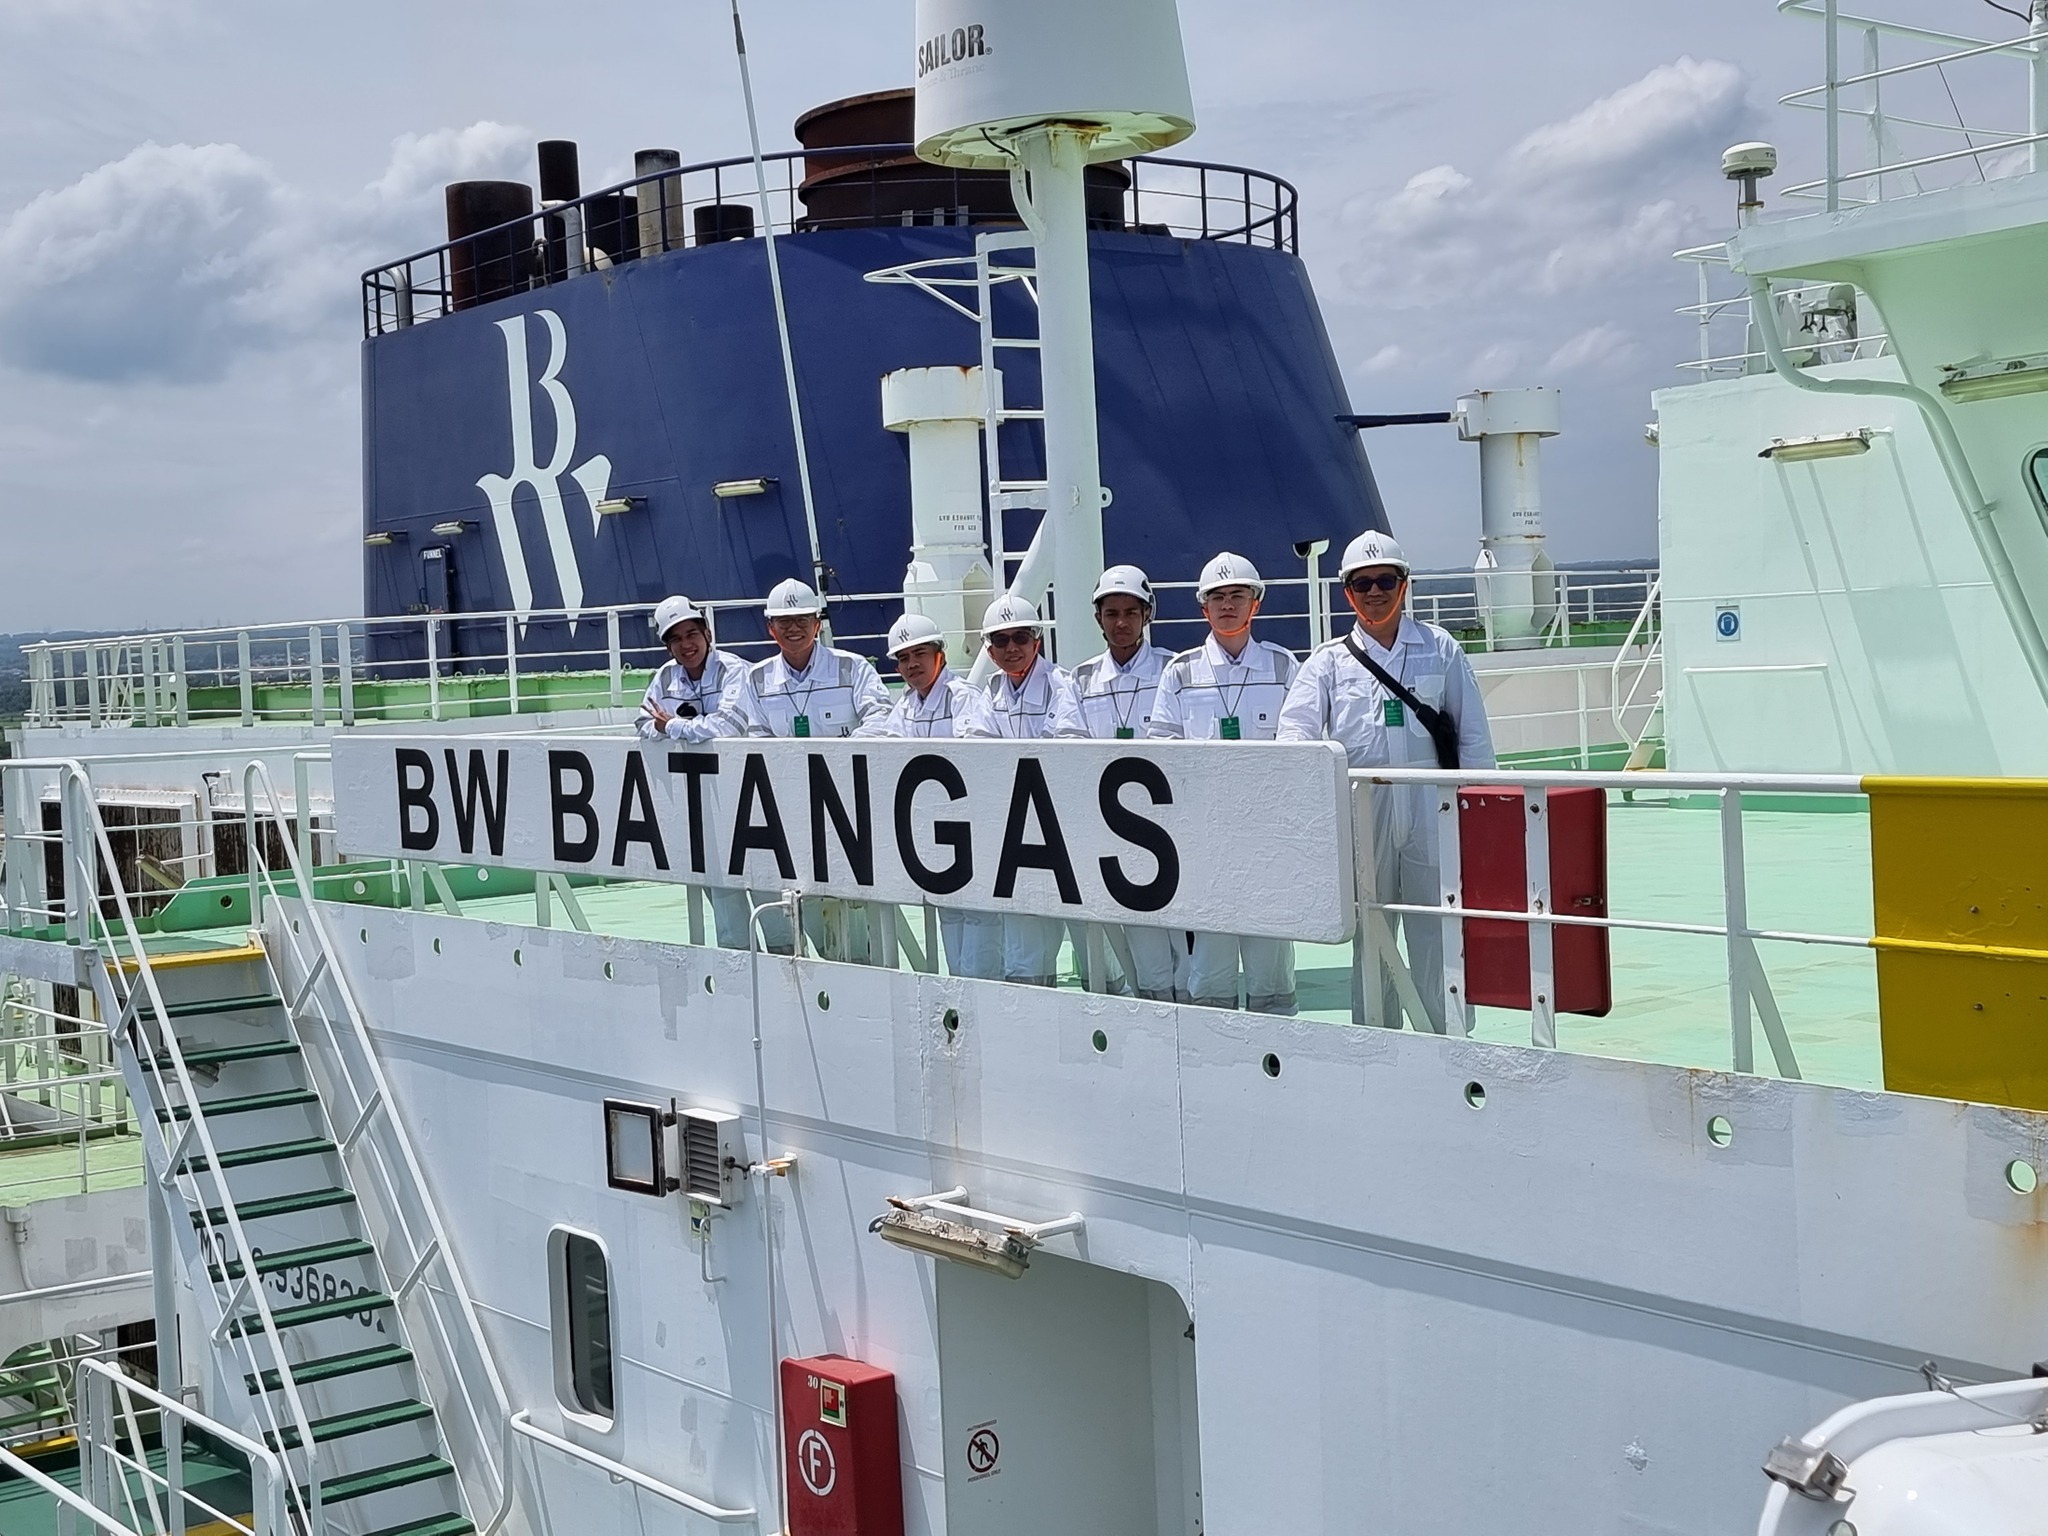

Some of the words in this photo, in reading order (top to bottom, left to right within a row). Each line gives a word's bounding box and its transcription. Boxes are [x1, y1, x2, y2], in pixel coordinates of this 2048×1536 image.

[395, 748, 509, 857] BW
[548, 750, 1181, 912] BATANGAS
[807, 1374, 819, 1389] 30
